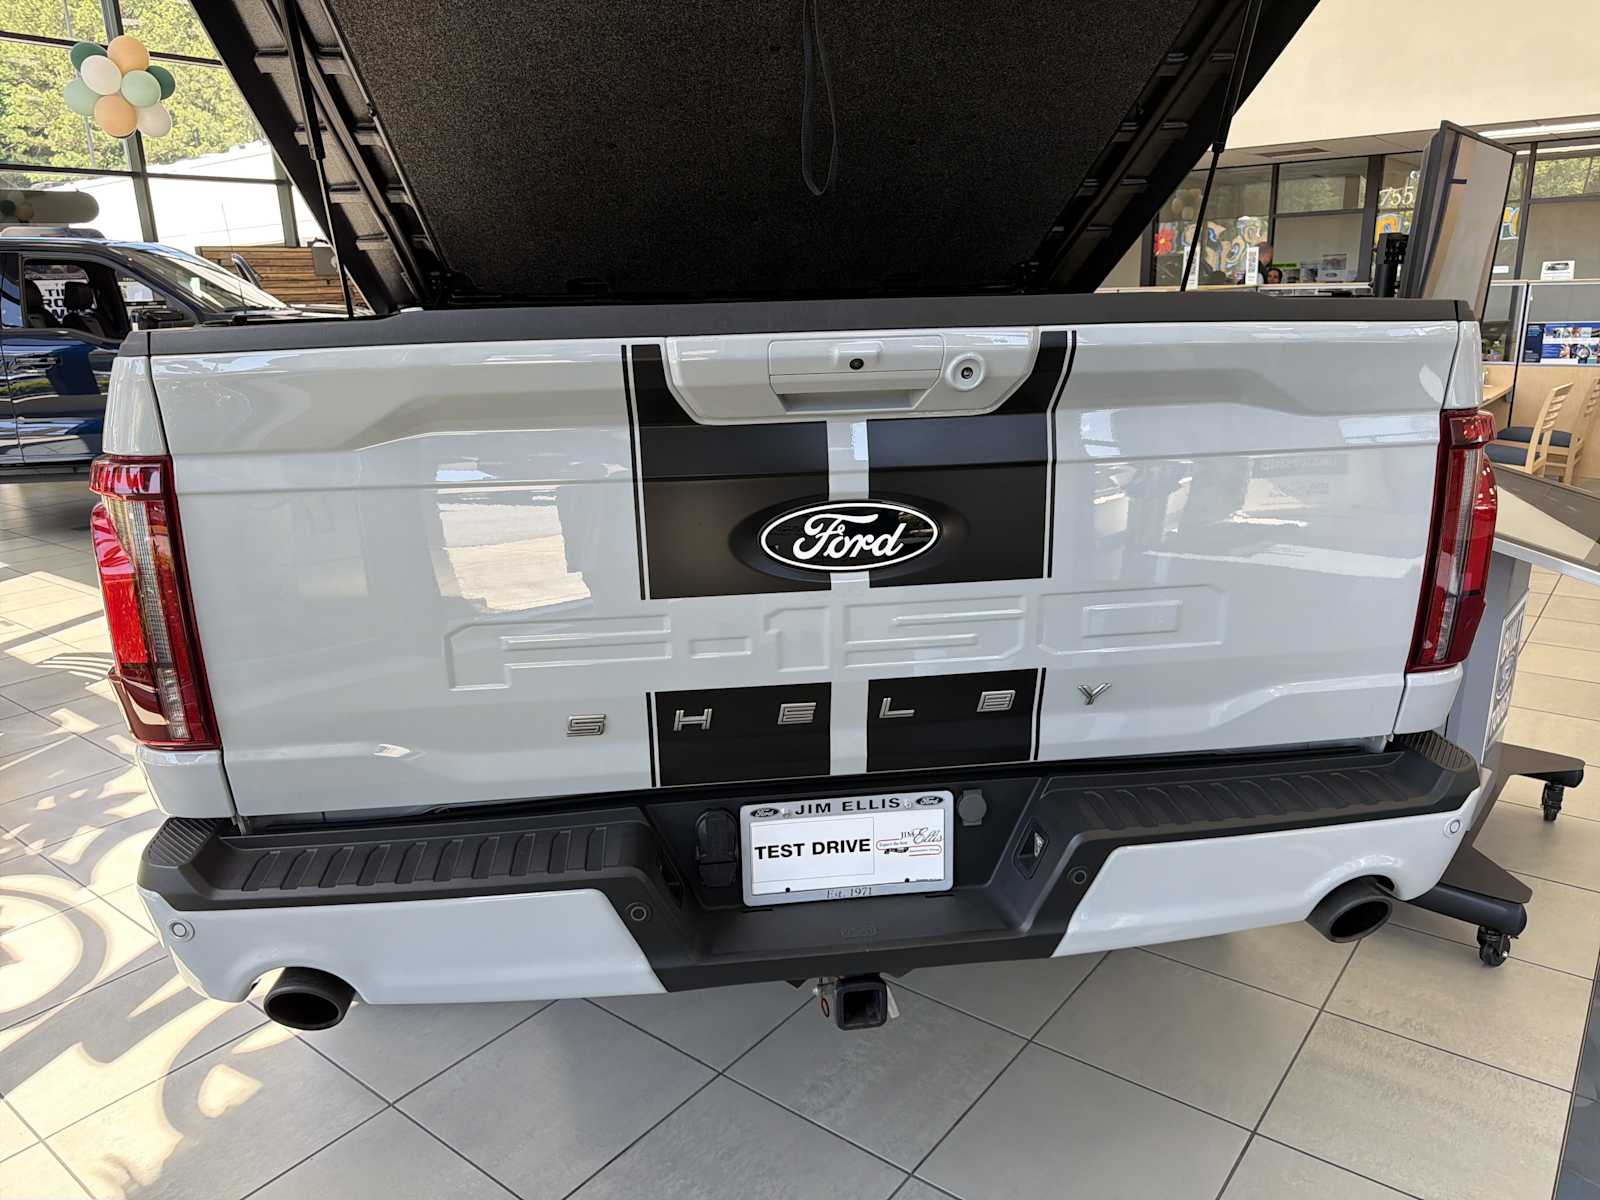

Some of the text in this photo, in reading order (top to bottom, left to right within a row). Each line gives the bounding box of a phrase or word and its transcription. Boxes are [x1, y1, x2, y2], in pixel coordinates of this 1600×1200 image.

[793, 513, 907, 560] Ford
[443, 584, 1229, 692] F-150
[566, 681, 1112, 738] SHELBY
[795, 797, 900, 815] JIM ELLIS
[901, 831, 915, 839] JIM
[754, 838, 871, 860] TEST DRIVE
[850, 886, 872, 896] 1971
